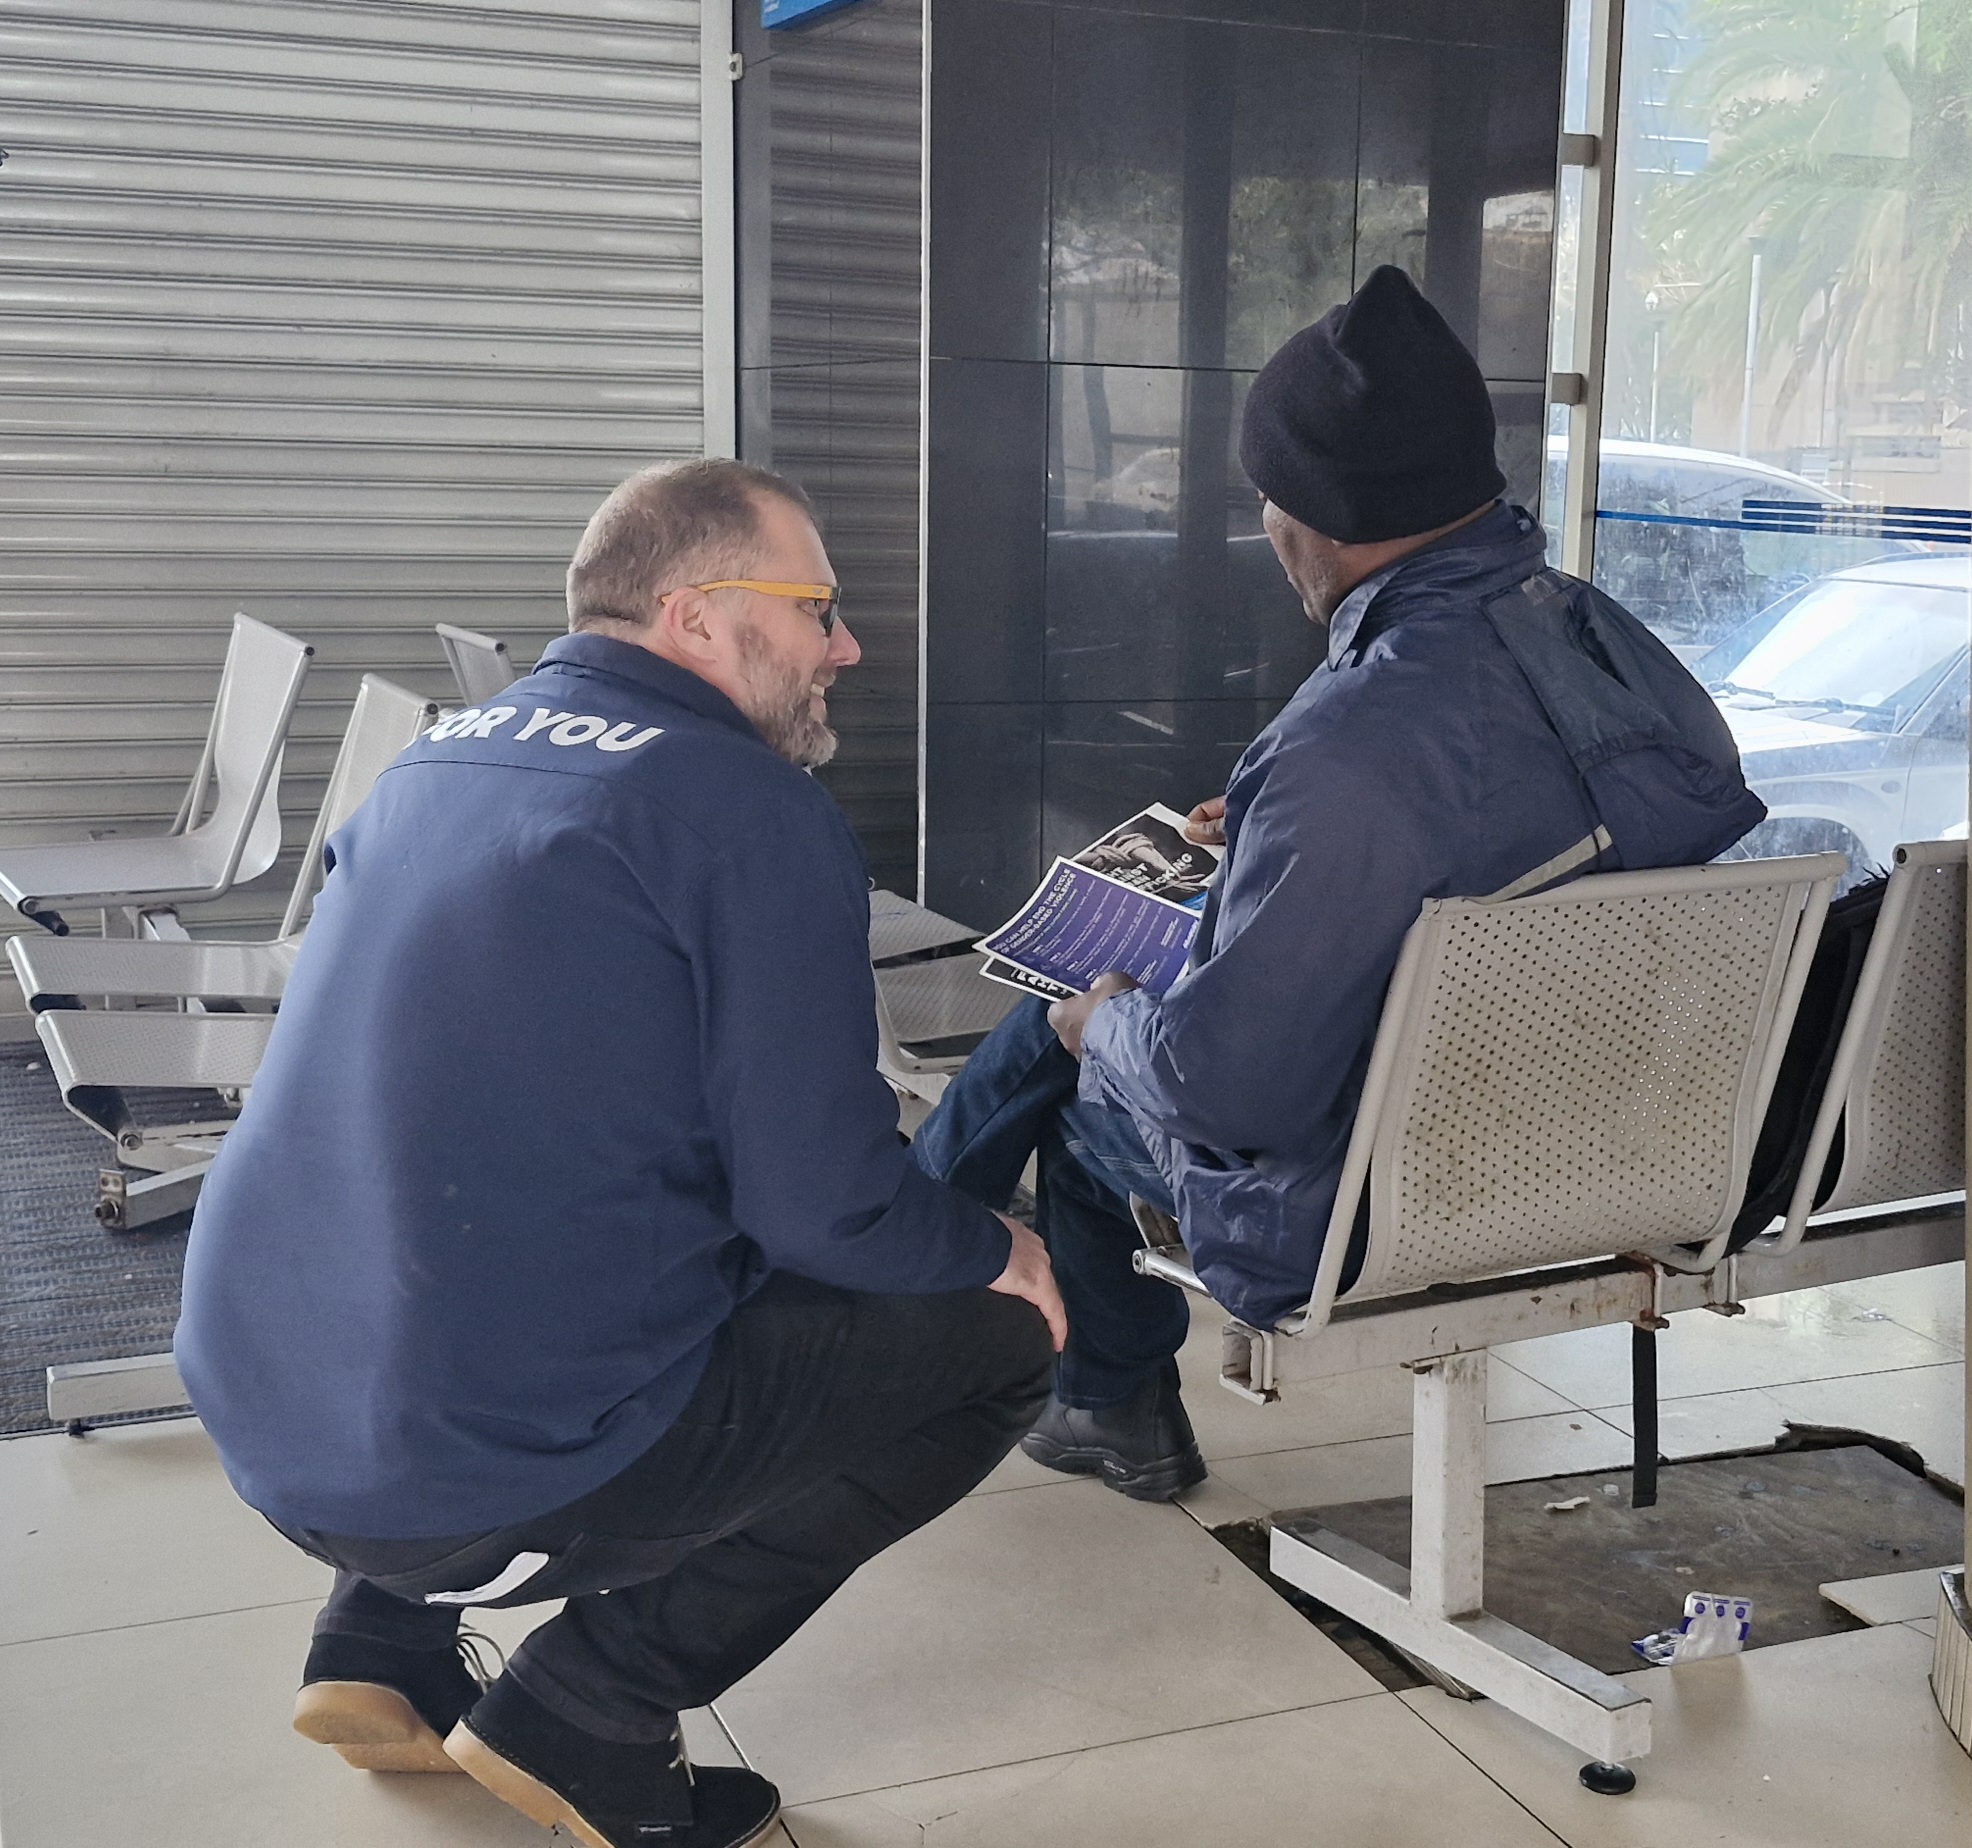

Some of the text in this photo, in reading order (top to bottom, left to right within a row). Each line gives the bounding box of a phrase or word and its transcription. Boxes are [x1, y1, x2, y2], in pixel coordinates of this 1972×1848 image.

[513, 707, 666, 752] YOU
[1051, 873, 1077, 908] VIOLENCE
[1017, 918, 1033, 934] HELP
[1032, 905, 1046, 919] END
[1043, 891, 1056, 906] THE
